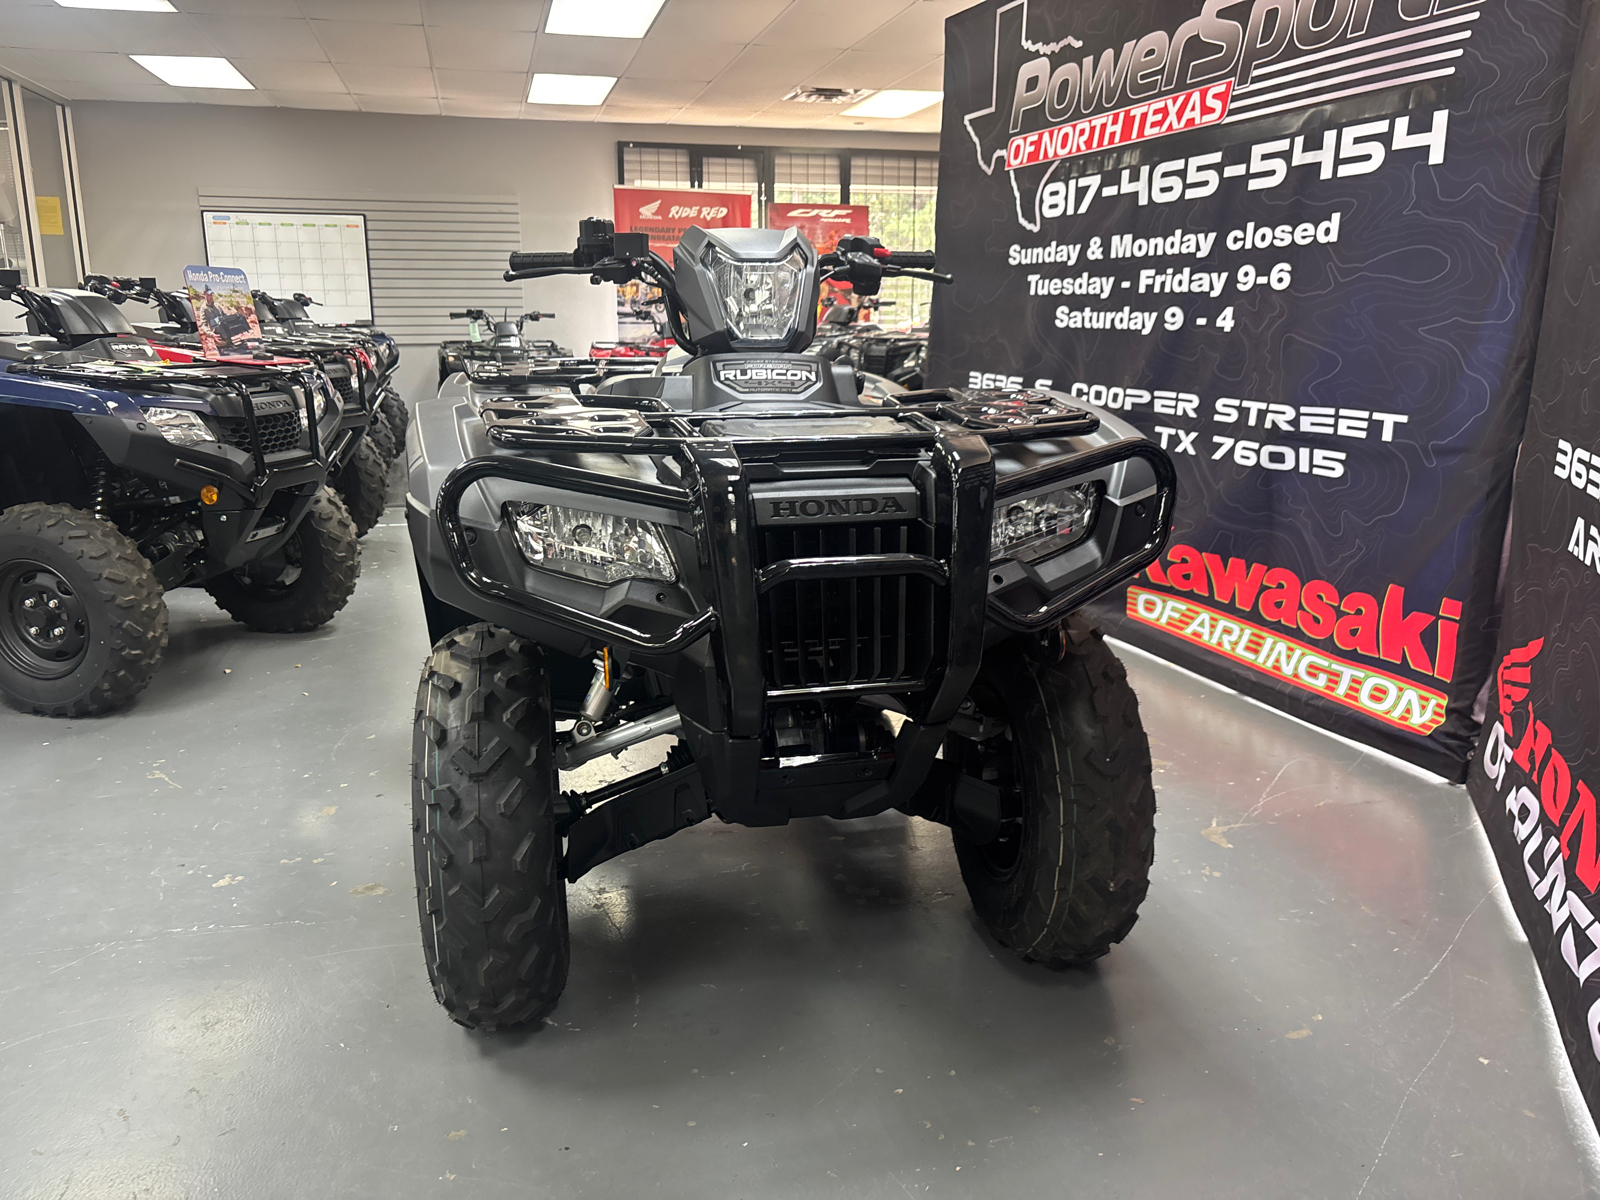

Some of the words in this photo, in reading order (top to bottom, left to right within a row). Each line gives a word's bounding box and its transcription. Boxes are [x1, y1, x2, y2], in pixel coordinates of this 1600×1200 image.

[1009, 134, 1039, 166] OF
[1039, 112, 1125, 160] NORTH
[1130, 83, 1227, 139] TEXAS
[1041, 109, 1449, 219] 817-465-5454
[668, 205, 700, 219] RIDE
[700, 206, 728, 221] RED
[786, 208, 853, 217] CRF
[1008, 242, 1081, 265] Sunday
[1087, 236, 1104, 260] &
[1110, 229, 1217, 259] Monday
[1226, 212, 1341, 251] closed
[187, 270, 208, 282] Honda
[207, 271, 246, 284] Pro-Connect
[1027, 272, 1115, 299] Tuesday
[1121, 280, 1131, 288] -
[1137, 266, 1229, 298] Friday
[1236, 262, 1292, 292] 9-6
[1054, 305, 1158, 335] Saturday
[1163, 306, 1184, 331] 9
[1196, 316, 1207, 325] -
[1215, 306, 1235, 332] 4
[720, 369, 816, 381] RUBICON
[1071, 382, 1200, 419] COOPER
[1213, 397, 1409, 442] STREET
[1154, 425, 1200, 456] TX
[1211, 435, 1347, 479] 76015
[769, 496, 907, 519] HONDA
[1137, 594, 1187, 624] OF
[1185, 612, 1437, 725] ARLINGTON
